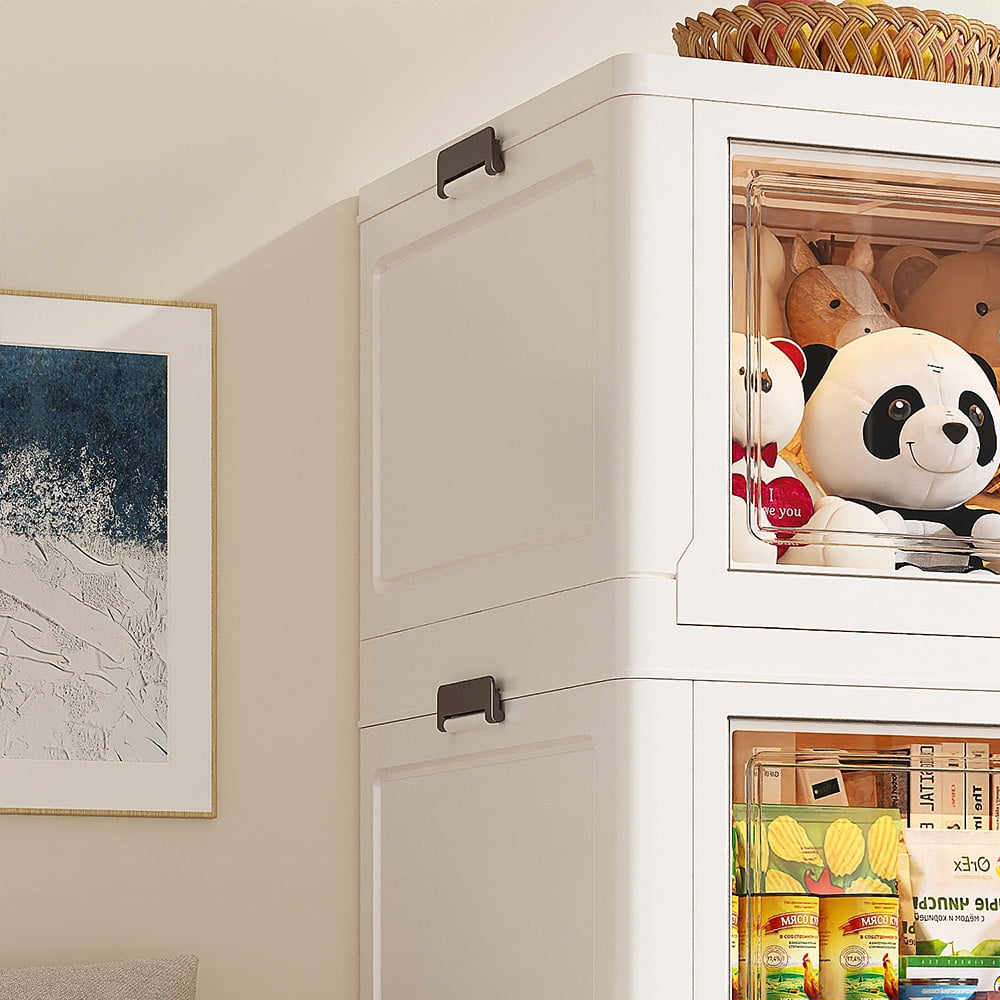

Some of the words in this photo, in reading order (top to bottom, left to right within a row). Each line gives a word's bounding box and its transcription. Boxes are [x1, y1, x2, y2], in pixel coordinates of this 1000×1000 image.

[768, 488, 774, 502] I
[778, 508, 802, 519] you
[780, 914, 808, 926] МЯСО
[861, 914, 888, 926] МЯСО
